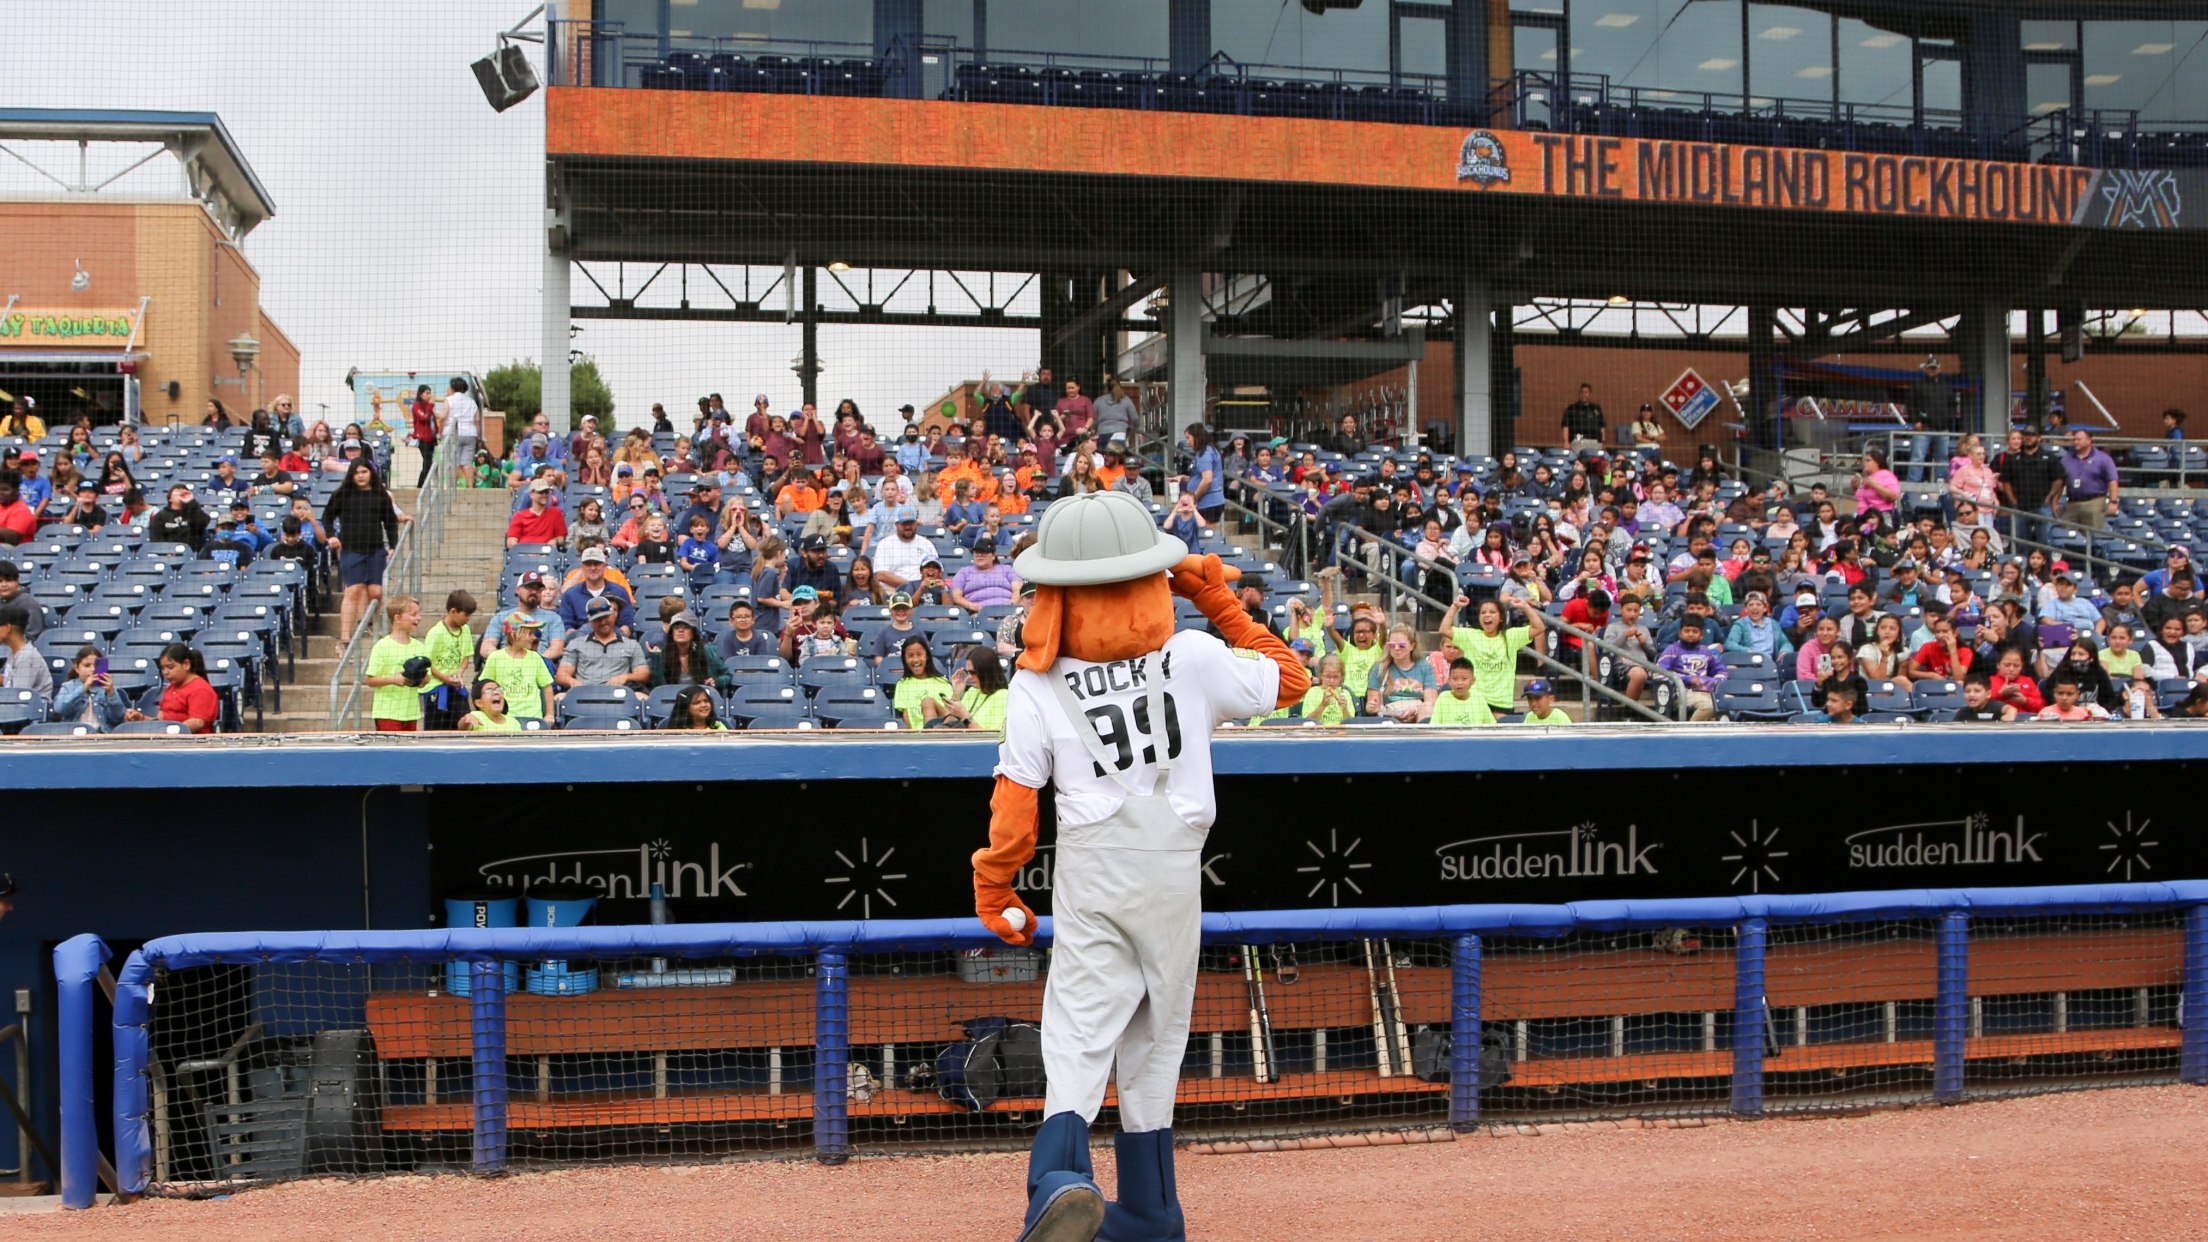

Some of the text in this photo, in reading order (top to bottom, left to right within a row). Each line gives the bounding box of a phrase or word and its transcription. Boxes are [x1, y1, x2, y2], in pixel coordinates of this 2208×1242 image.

[1533, 134, 1622, 197] THE
[1636, 140, 1830, 209] MIDLAND
[30, 314, 130, 337] TAQUERIA
[1084, 691, 1183, 778] 99
[1440, 824, 1659, 880] suddenlink
[1849, 814, 2043, 868] suddenlink
